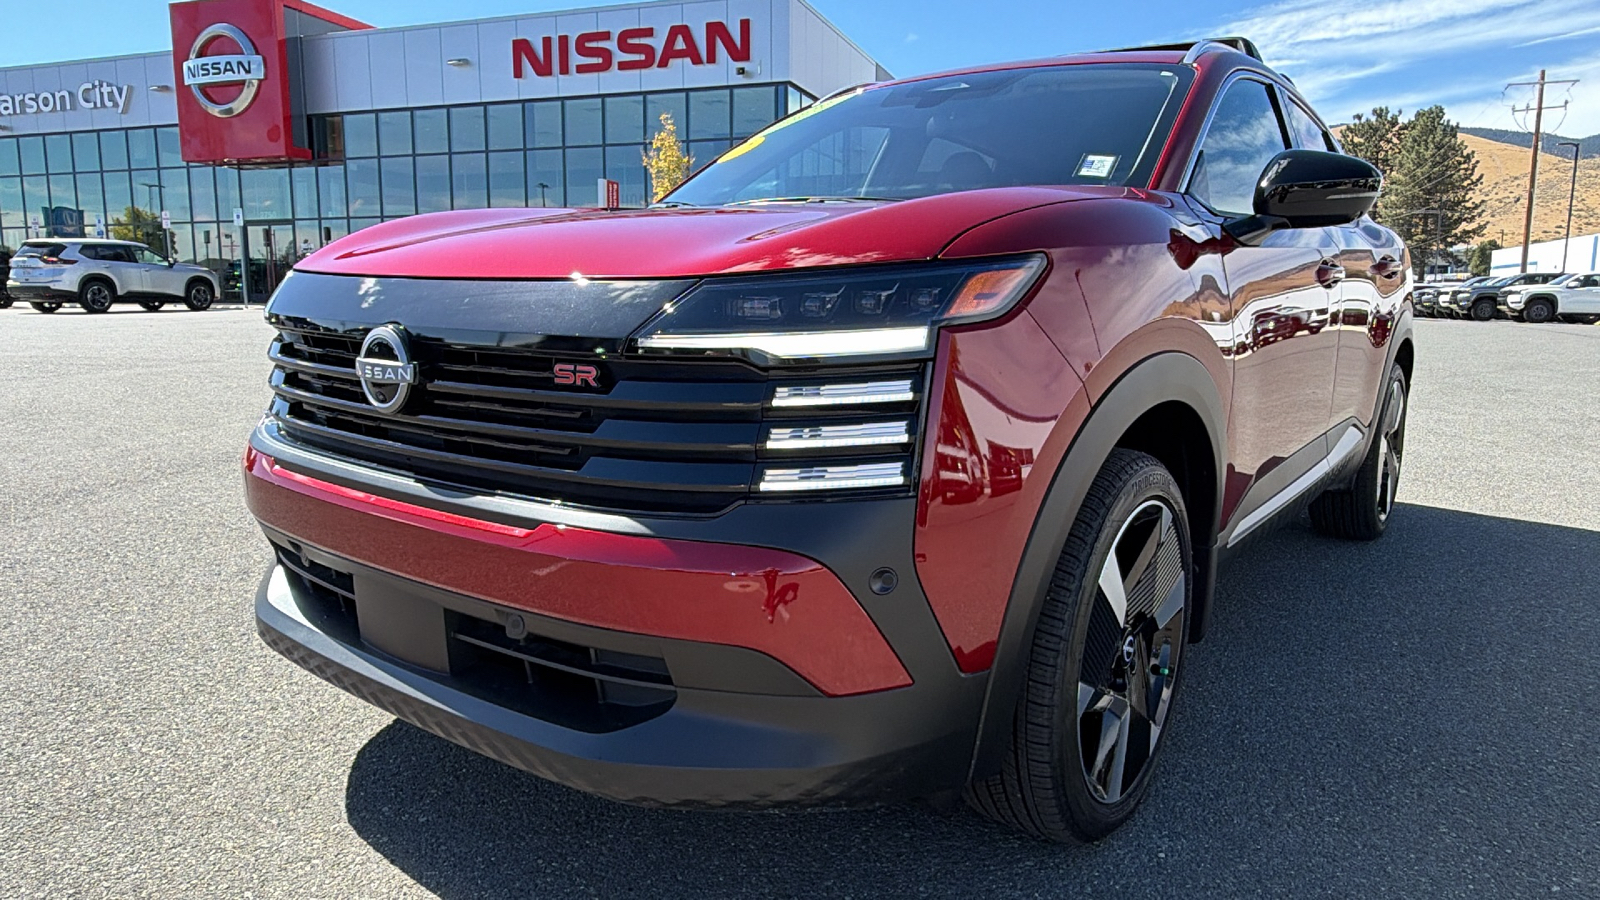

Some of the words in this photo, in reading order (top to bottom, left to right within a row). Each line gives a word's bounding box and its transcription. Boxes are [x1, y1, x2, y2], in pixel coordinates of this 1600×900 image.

[512, 18, 751, 79] NISSAN
[187, 60, 252, 79] NISSAN
[78, 80, 128, 114] City
[362, 364, 411, 382] SSAN
[554, 364, 598, 387] SR
